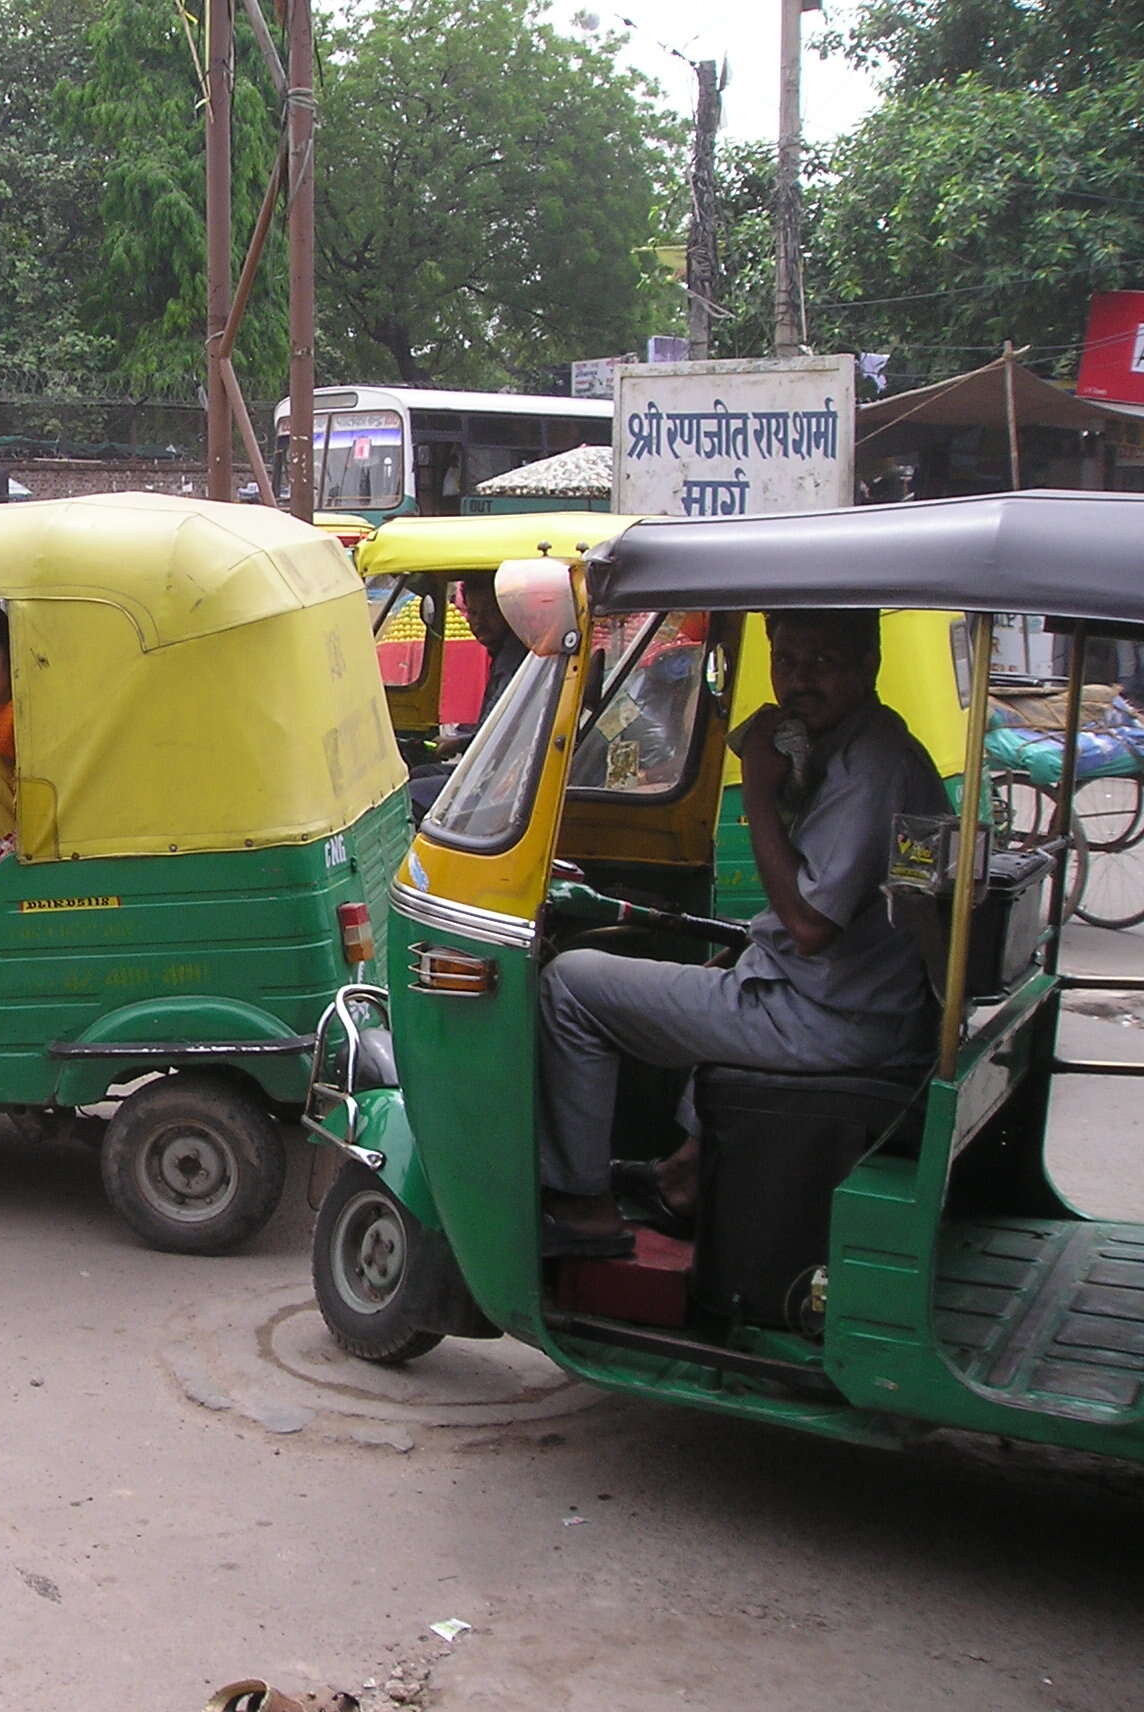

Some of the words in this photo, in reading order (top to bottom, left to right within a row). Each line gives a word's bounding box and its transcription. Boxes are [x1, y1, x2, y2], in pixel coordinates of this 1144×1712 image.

[627, 401, 663, 460] श्री
[666, 398, 750, 460] रणजीत
[752, 411, 789, 459] राय
[792, 397, 838, 460] शर्मा
[681, 467, 750, 516] मार्ग
[324, 834, 347, 868] CNG
